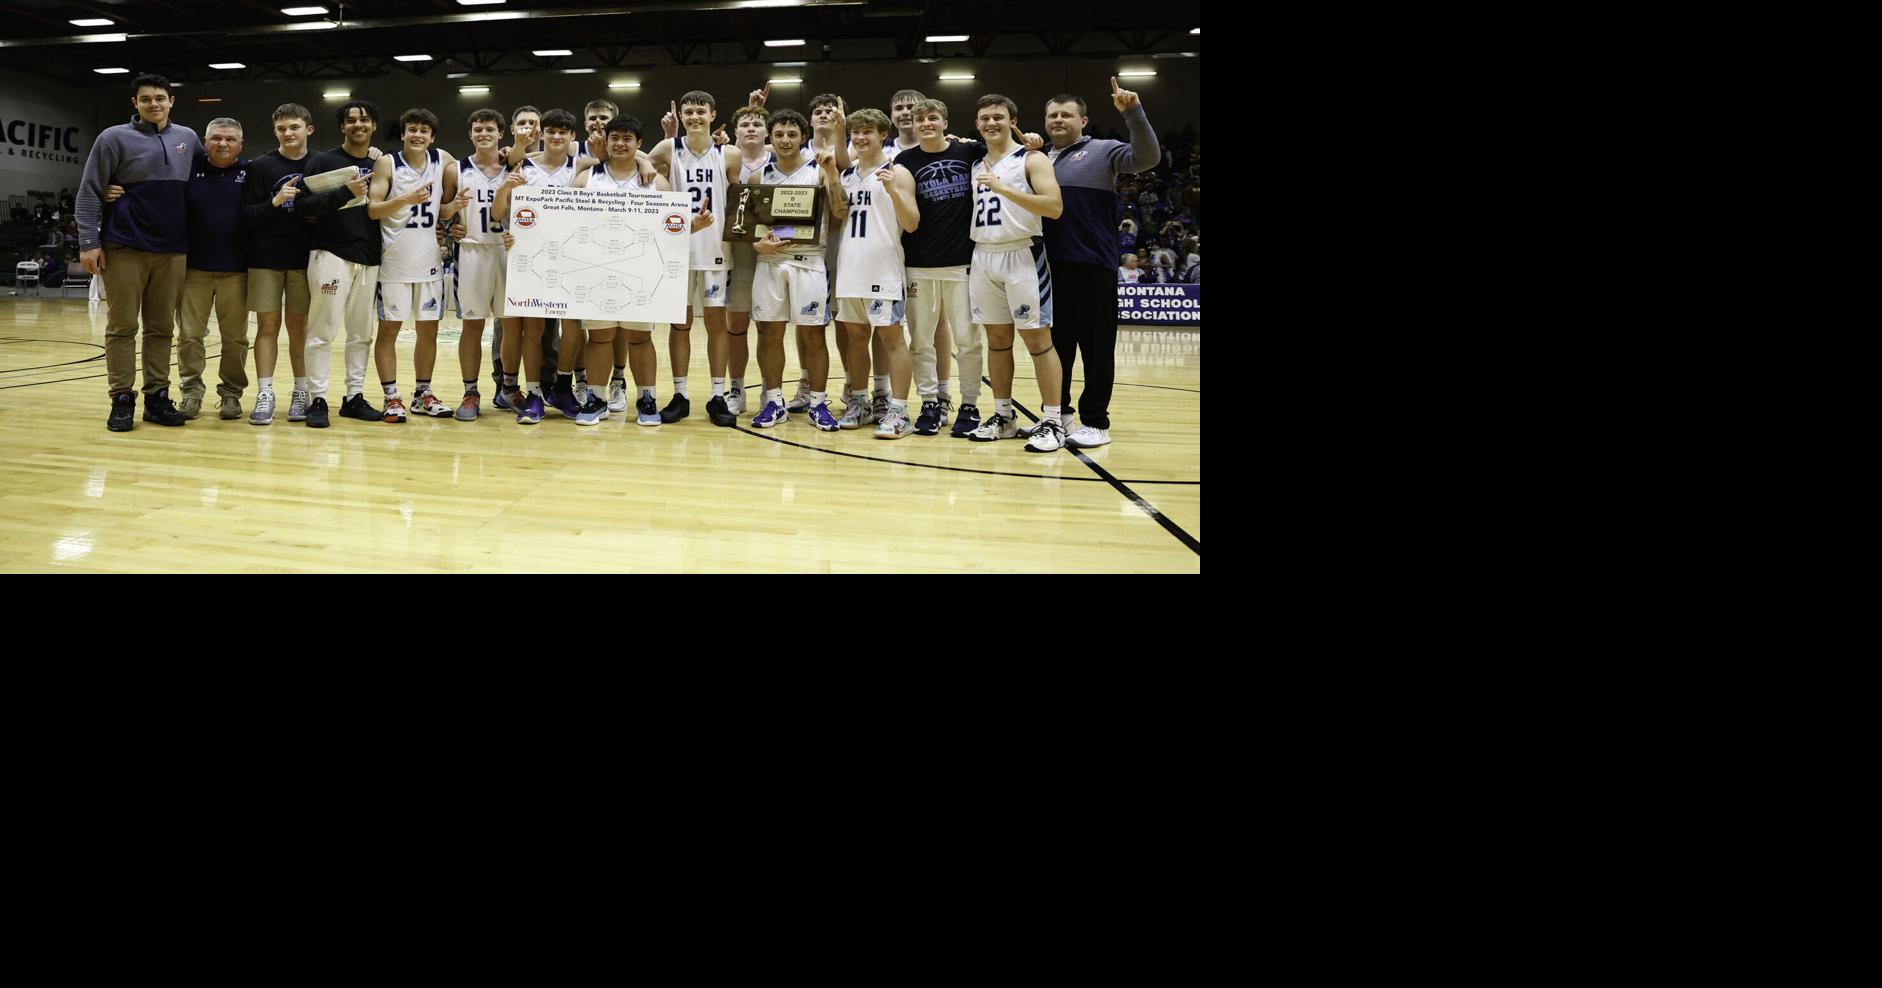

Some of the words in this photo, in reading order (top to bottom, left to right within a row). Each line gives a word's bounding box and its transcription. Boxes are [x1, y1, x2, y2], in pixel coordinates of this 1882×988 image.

[21, 149, 79, 165] RECYCLING
[686, 168, 713, 183] LSH
[687, 186, 713, 213] 21
[848, 190, 871, 206] LSH
[405, 201, 434, 229] 25
[975, 196, 1002, 228] 22
[850, 210, 867, 238] 11
[1117, 286, 1186, 296] MONTANA
[508, 297, 568, 309] NorthWestern
[1140, 299, 1200, 308] SCHOOL
[545, 308, 567, 317] Energy
[1118, 311, 1200, 320] SOCIATION
